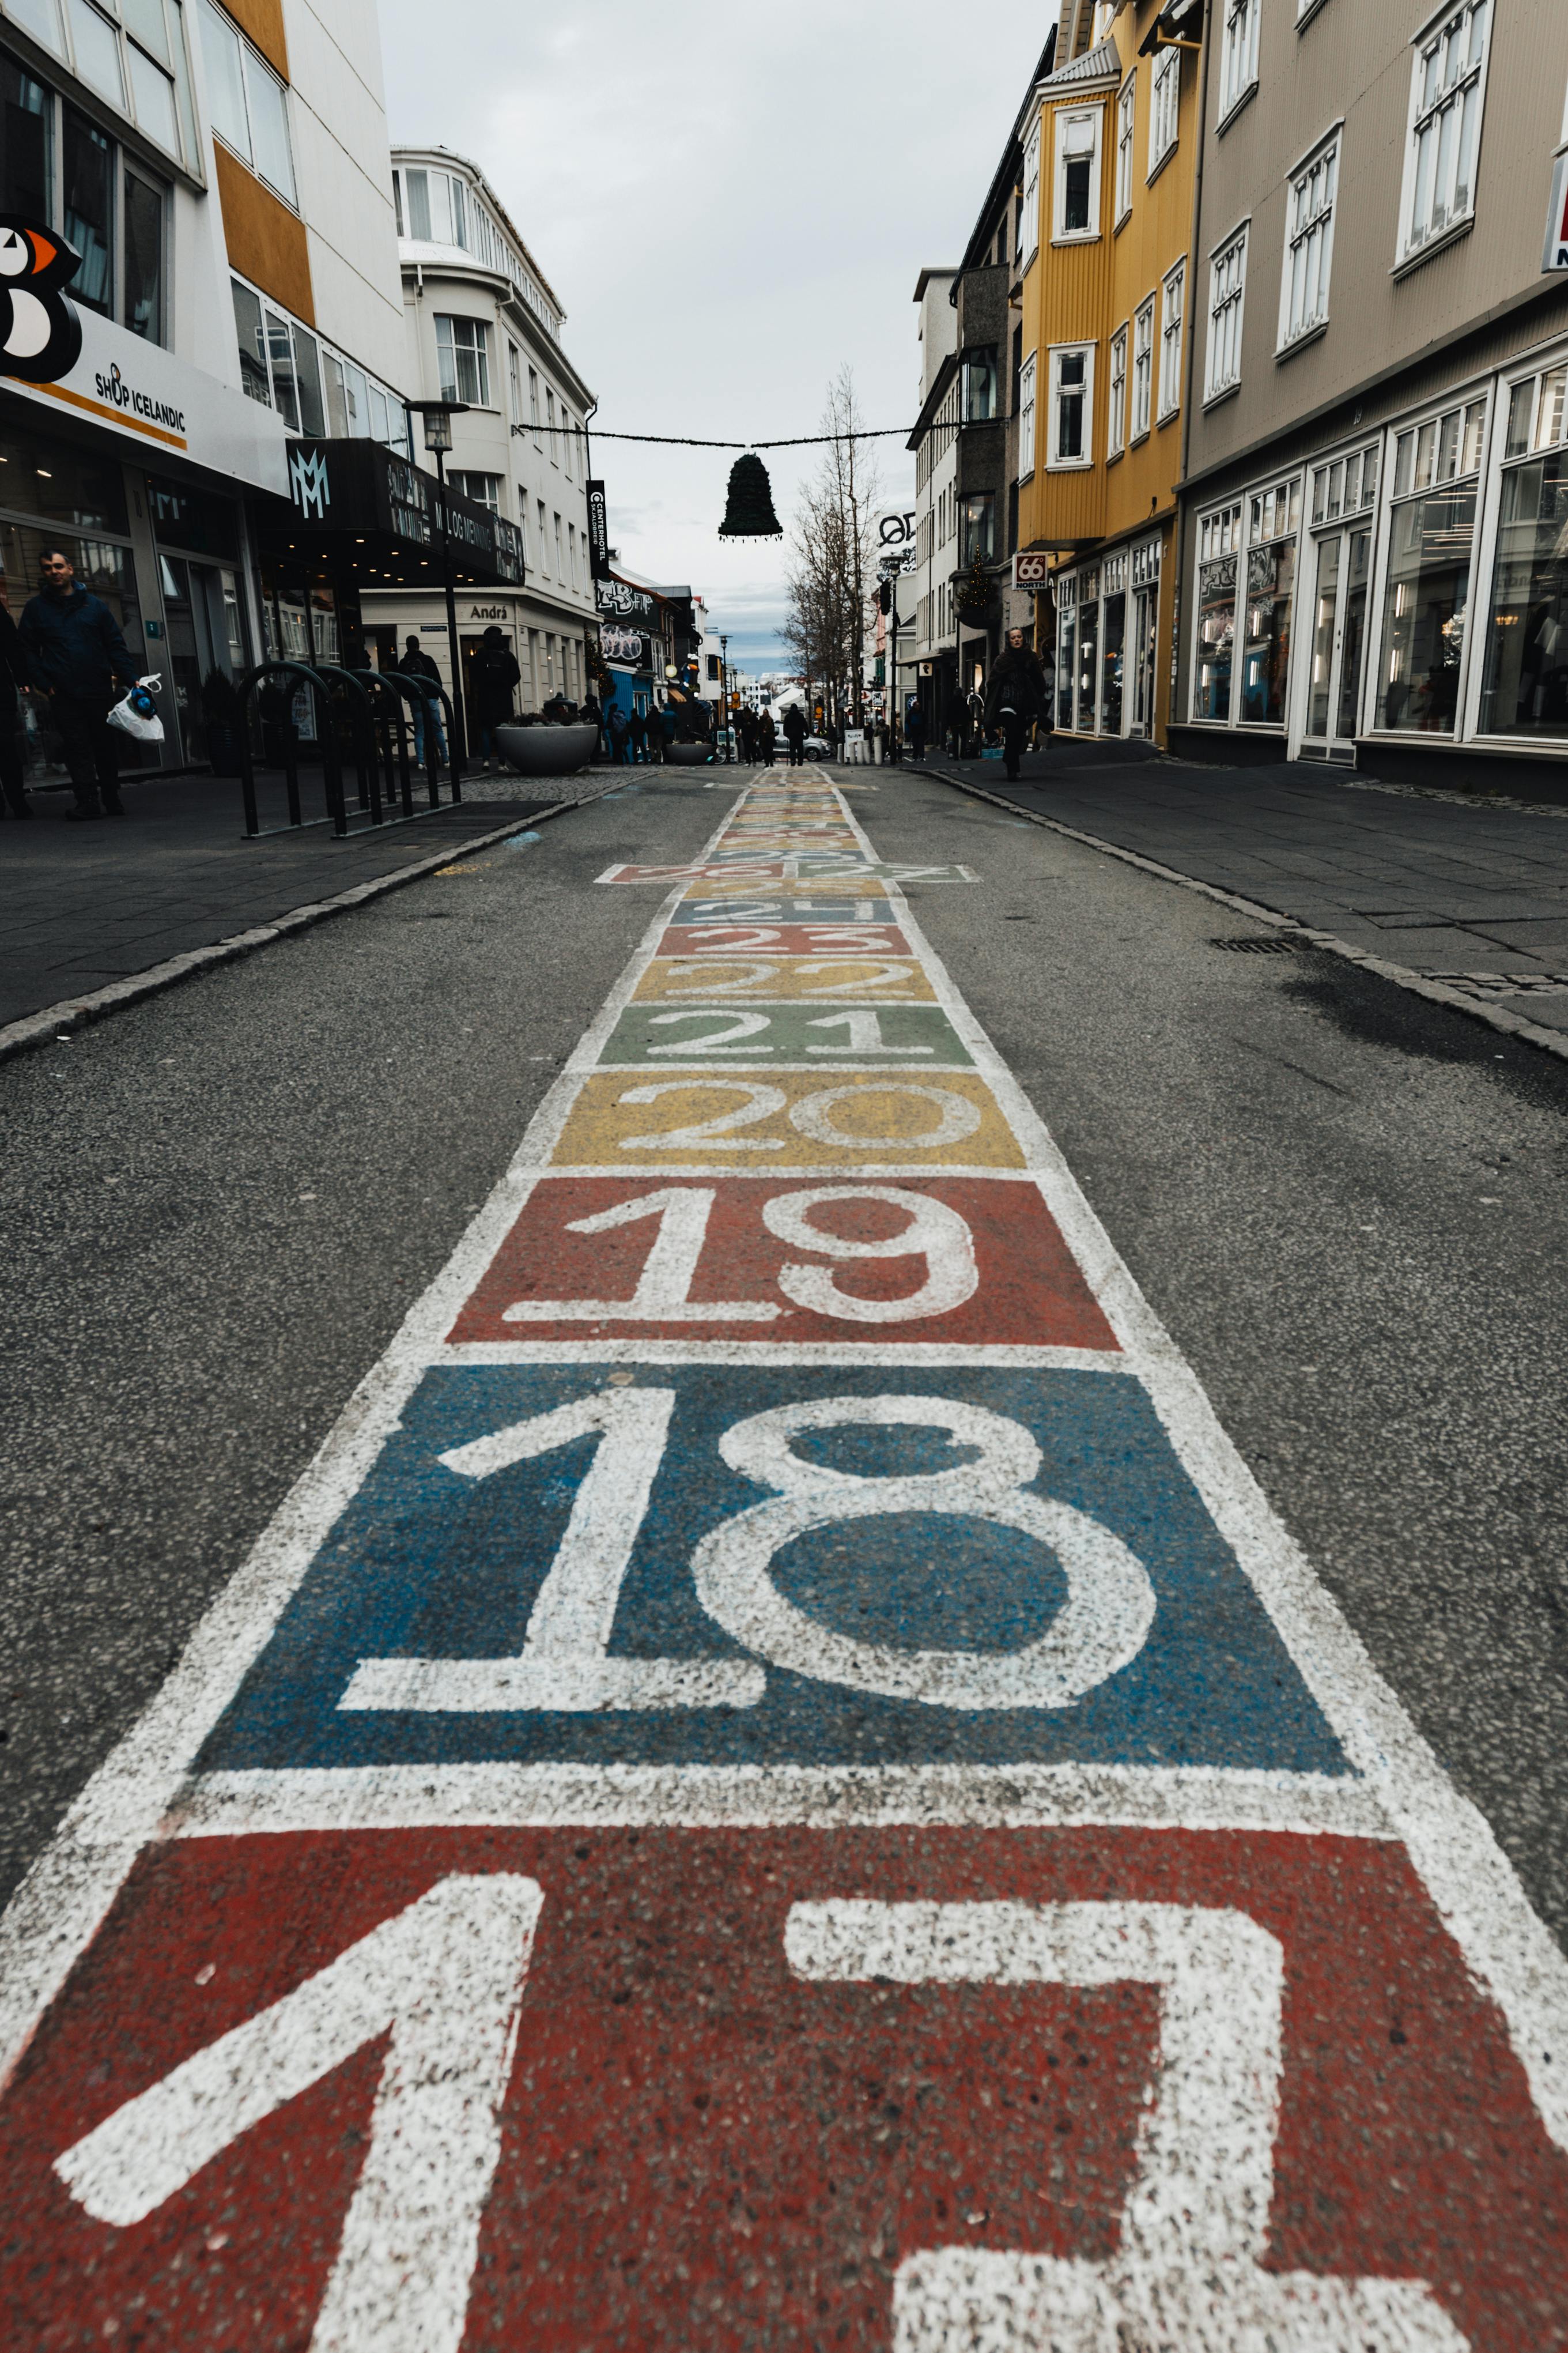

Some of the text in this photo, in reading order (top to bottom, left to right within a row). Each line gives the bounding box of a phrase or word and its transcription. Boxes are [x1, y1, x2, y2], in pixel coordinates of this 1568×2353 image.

[96, 363, 186, 432] SHOP ICELANDIC
[435, 501, 452, 536] ML
[452, 510, 463, 540] OG
[596, 503, 606, 561] CENTERHOTEL
[470, 605, 507, 619] Andrá
[730, 831, 850, 839] 30
[630, 866, 773, 881] 26
[719, 850, 857, 862] 28
[803, 865, 951, 879] 27
[711, 880, 864, 897] 25
[693, 901, 874, 921] 24
[687, 927, 893, 953] 23
[665, 961, 916, 996] 22
[647, 1010, 935, 1054] 21
[617, 1079, 983, 1153] 20
[501, 1185, 980, 1322] 19
[337, 1386, 1156, 1711] 18
[52, 1872, 1472, 2353] 17
